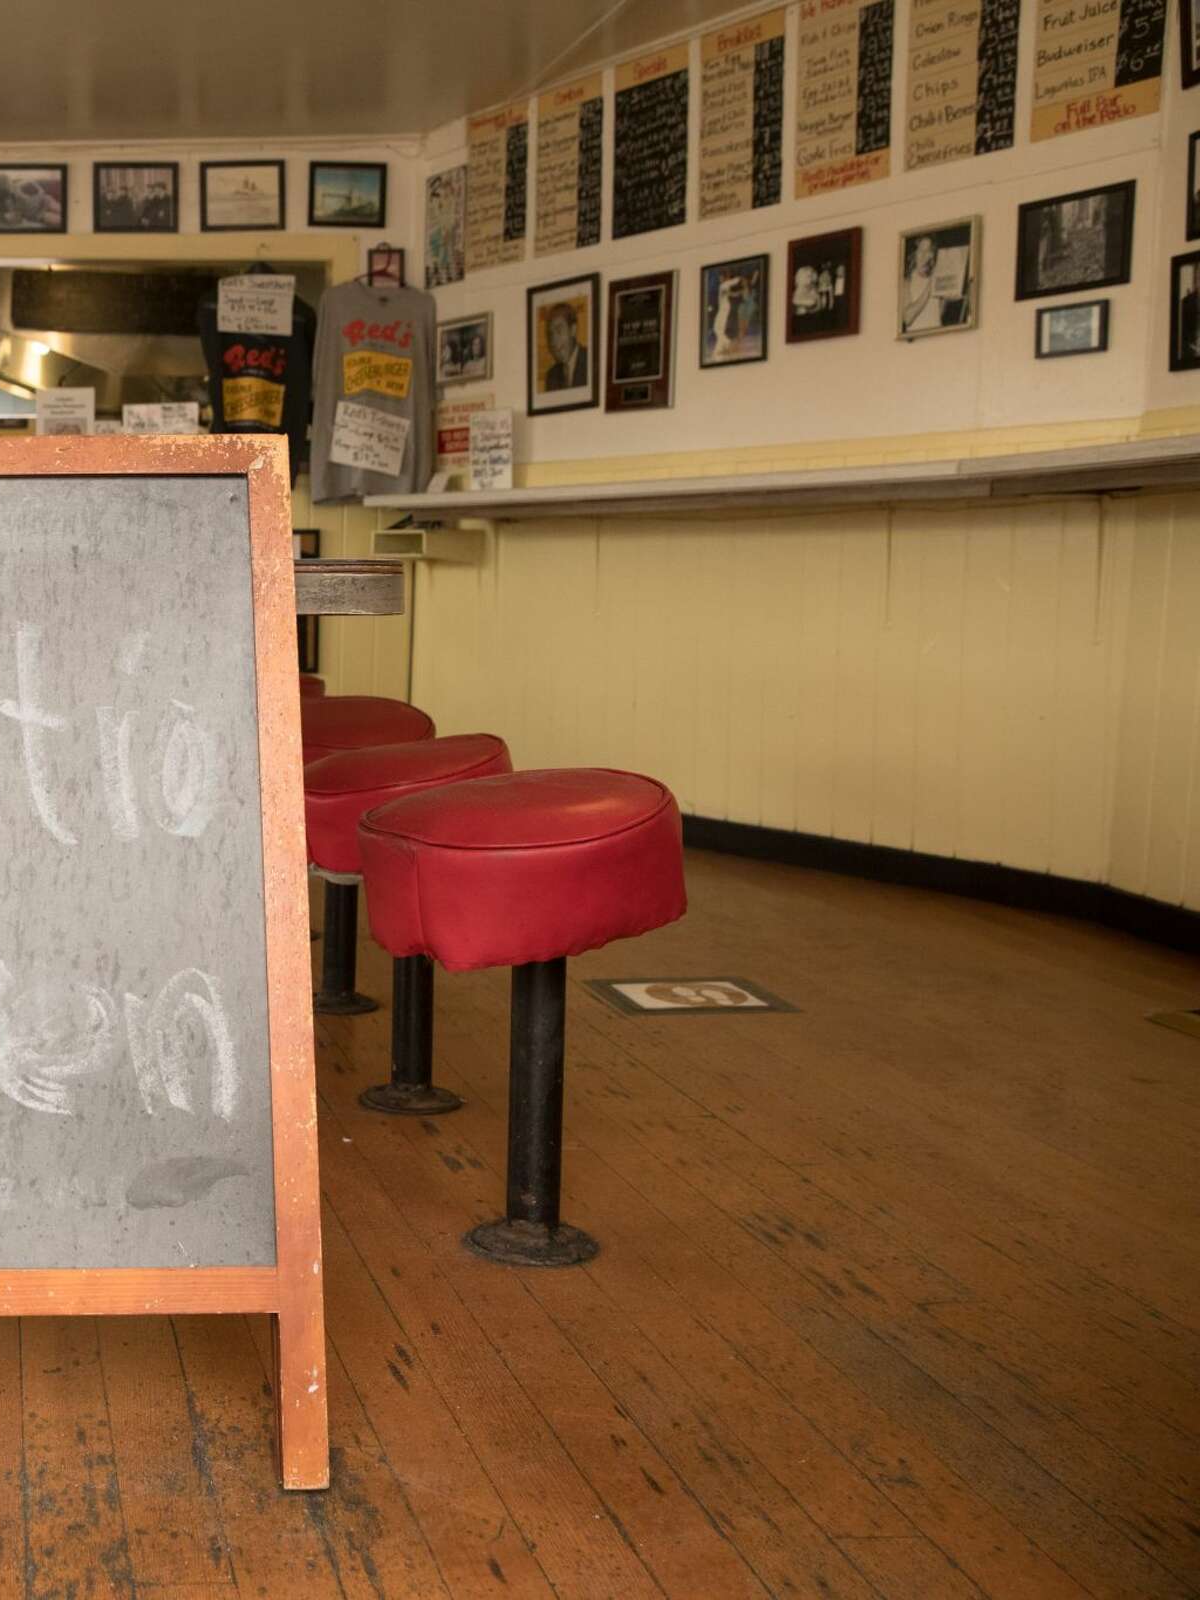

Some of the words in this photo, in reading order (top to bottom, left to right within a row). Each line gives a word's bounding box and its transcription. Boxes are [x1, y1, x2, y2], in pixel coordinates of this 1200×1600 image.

[1043, 11, 1075, 31] Fruit
[1036, 34, 1114, 68] Budweiser
[913, 79, 959, 101] Chips
[1066, 99, 1091, 120] Full
[341, 319, 416, 349] Red's
[223, 343, 287, 375] Red's
